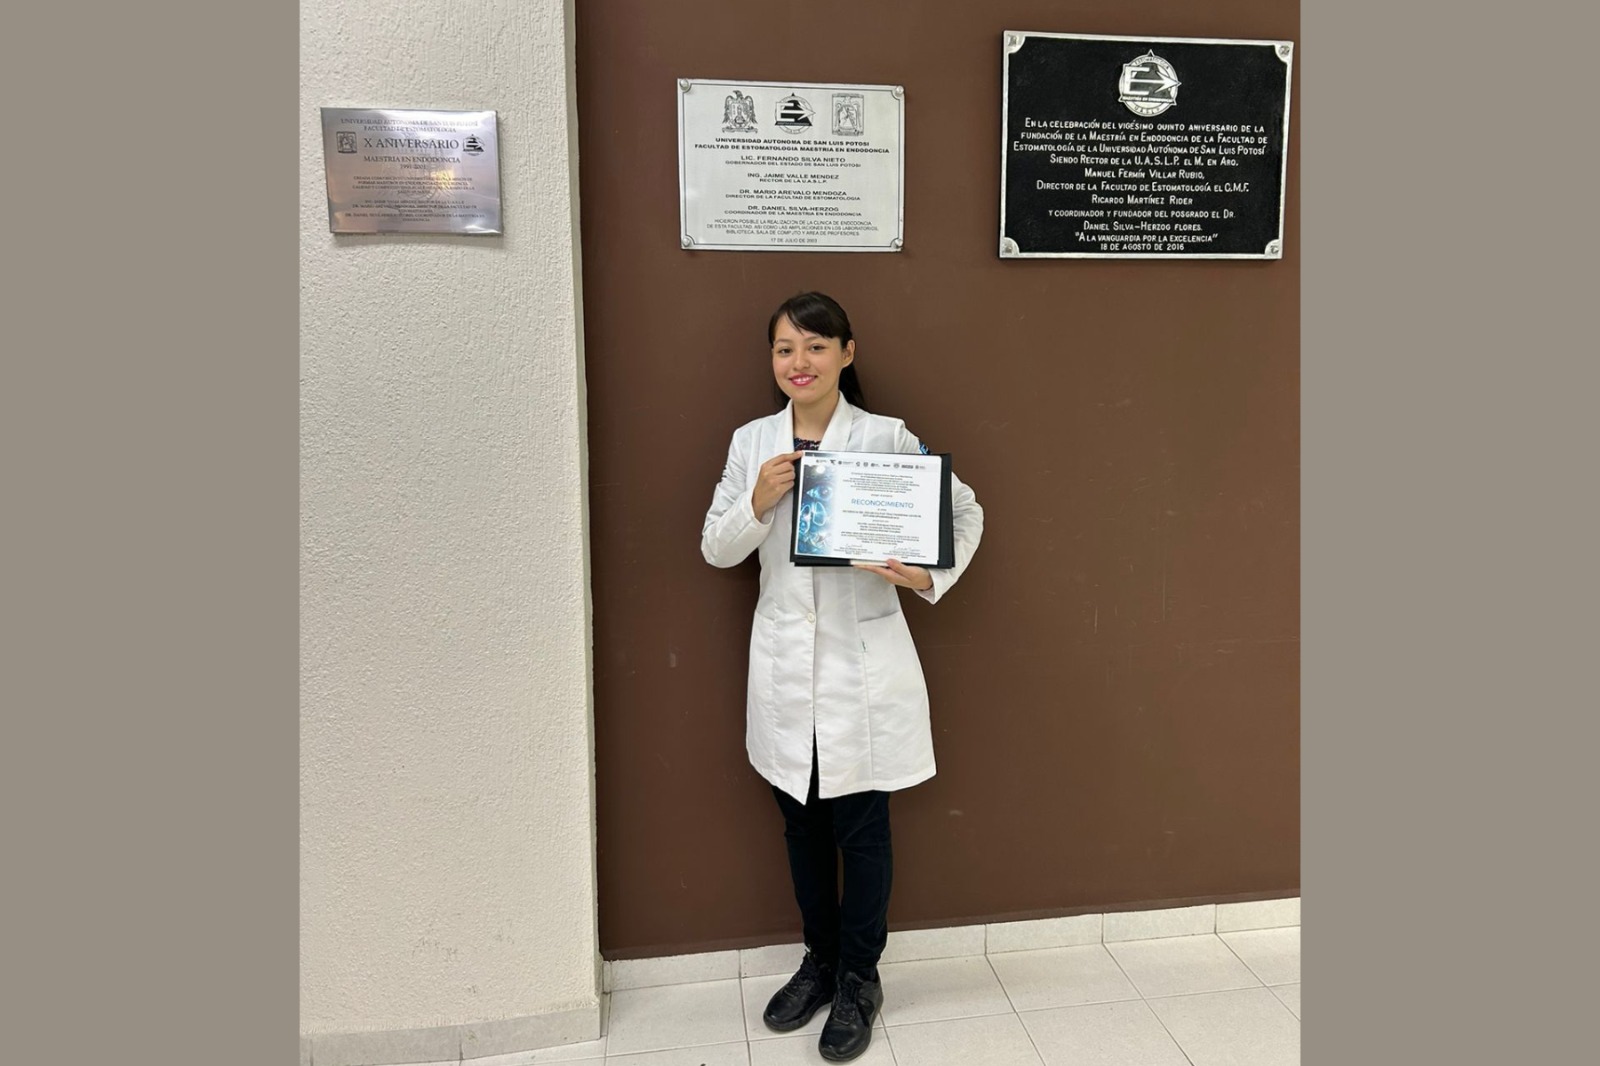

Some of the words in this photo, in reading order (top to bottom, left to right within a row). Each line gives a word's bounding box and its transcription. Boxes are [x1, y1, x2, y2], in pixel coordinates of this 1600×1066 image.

[1025, 117, 1036, 128] EN
[1049, 119, 1100, 129] CELEBRACIÓN
[1118, 120, 1154, 131] VIGÉSIMO
[1188, 124, 1238, 132] ANIVERSARIO
[1020, 130, 1062, 140] FUNDACIÓN
[1089, 131, 1126, 141] MAESTRÍA
[1140, 132, 1189, 142] ENDODONCIA
[1217, 133, 1255, 144] FACULTAD
[364, 138, 372, 148] X
[376, 138, 460, 149] ANIVERSARIO
[1013, 141, 1076, 152] ESTOMATOLOGÍA
[1099, 144, 1146, 154] UNIVERSIDAD
[1147, 144, 1188, 154] AUTÓNOMA
[1200, 144, 1216, 154] SAN
[1218, 145, 1236, 155] LUIS
[1237, 145, 1267, 155] POTOSÍ
[1050, 153, 1079, 164] SIENDO
[1080, 154, 1109, 164] RECTOR
[1194, 156, 1204, 166] M.
[1084, 167, 1116, 178] MANUEL
[1118, 168, 1146, 178] FERMÍN
[1148, 169, 1176, 179] VILLAR
[1178, 169, 1205, 180] RUBIO,
[1036, 180, 1074, 190] DIRECTOR
[1101, 181, 1138, 191] FACULTAD
[1152, 182, 1212, 192] ESTOMATOLOGÍA
[1092, 194, 1124, 204] RICARDO
[1127, 194, 1165, 205] MARTÍNEZ
[1169, 195, 1193, 205] RIDER
[1054, 210, 1104, 218] COORDINADOR
[1083, 220, 1110, 231] DANIEL
[1113, 221, 1171, 231] SILVA-HERZOG
[851, 498, 914, 509] RECONOCIMIENTO
